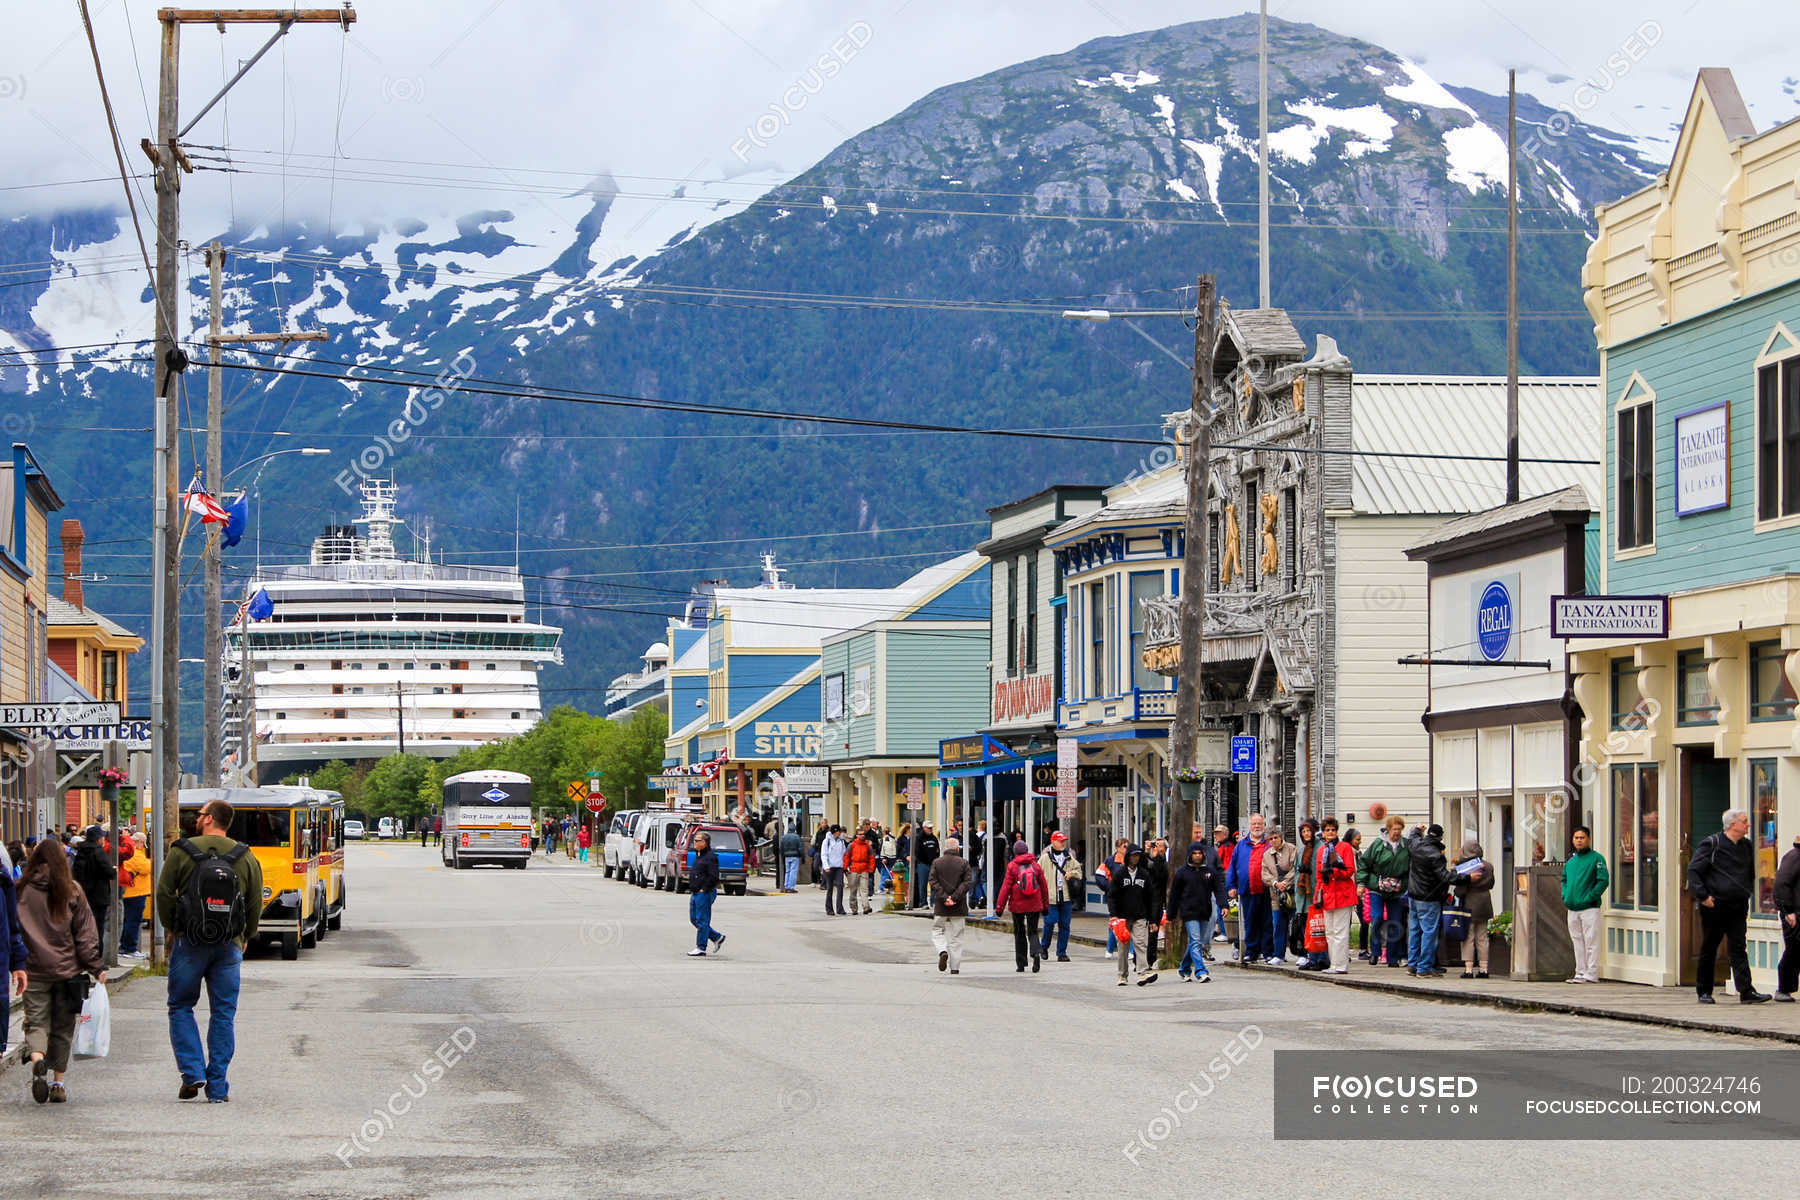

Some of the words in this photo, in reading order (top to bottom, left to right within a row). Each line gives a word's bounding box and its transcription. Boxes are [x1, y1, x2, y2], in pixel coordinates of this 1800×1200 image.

[1680, 425, 1726, 455] TANZANITE
[1680, 447, 1726, 470] INTERNATIONAL
[1683, 474, 1723, 494] ALASKA
[1479, 604, 1510, 633] REGAL
[1561, 604, 1658, 617] TANZANITE
[1561, 619, 1658, 629] INTERNATIONAL
[0, 708, 60, 723] ELRY
[586, 798, 605, 807] STOP
